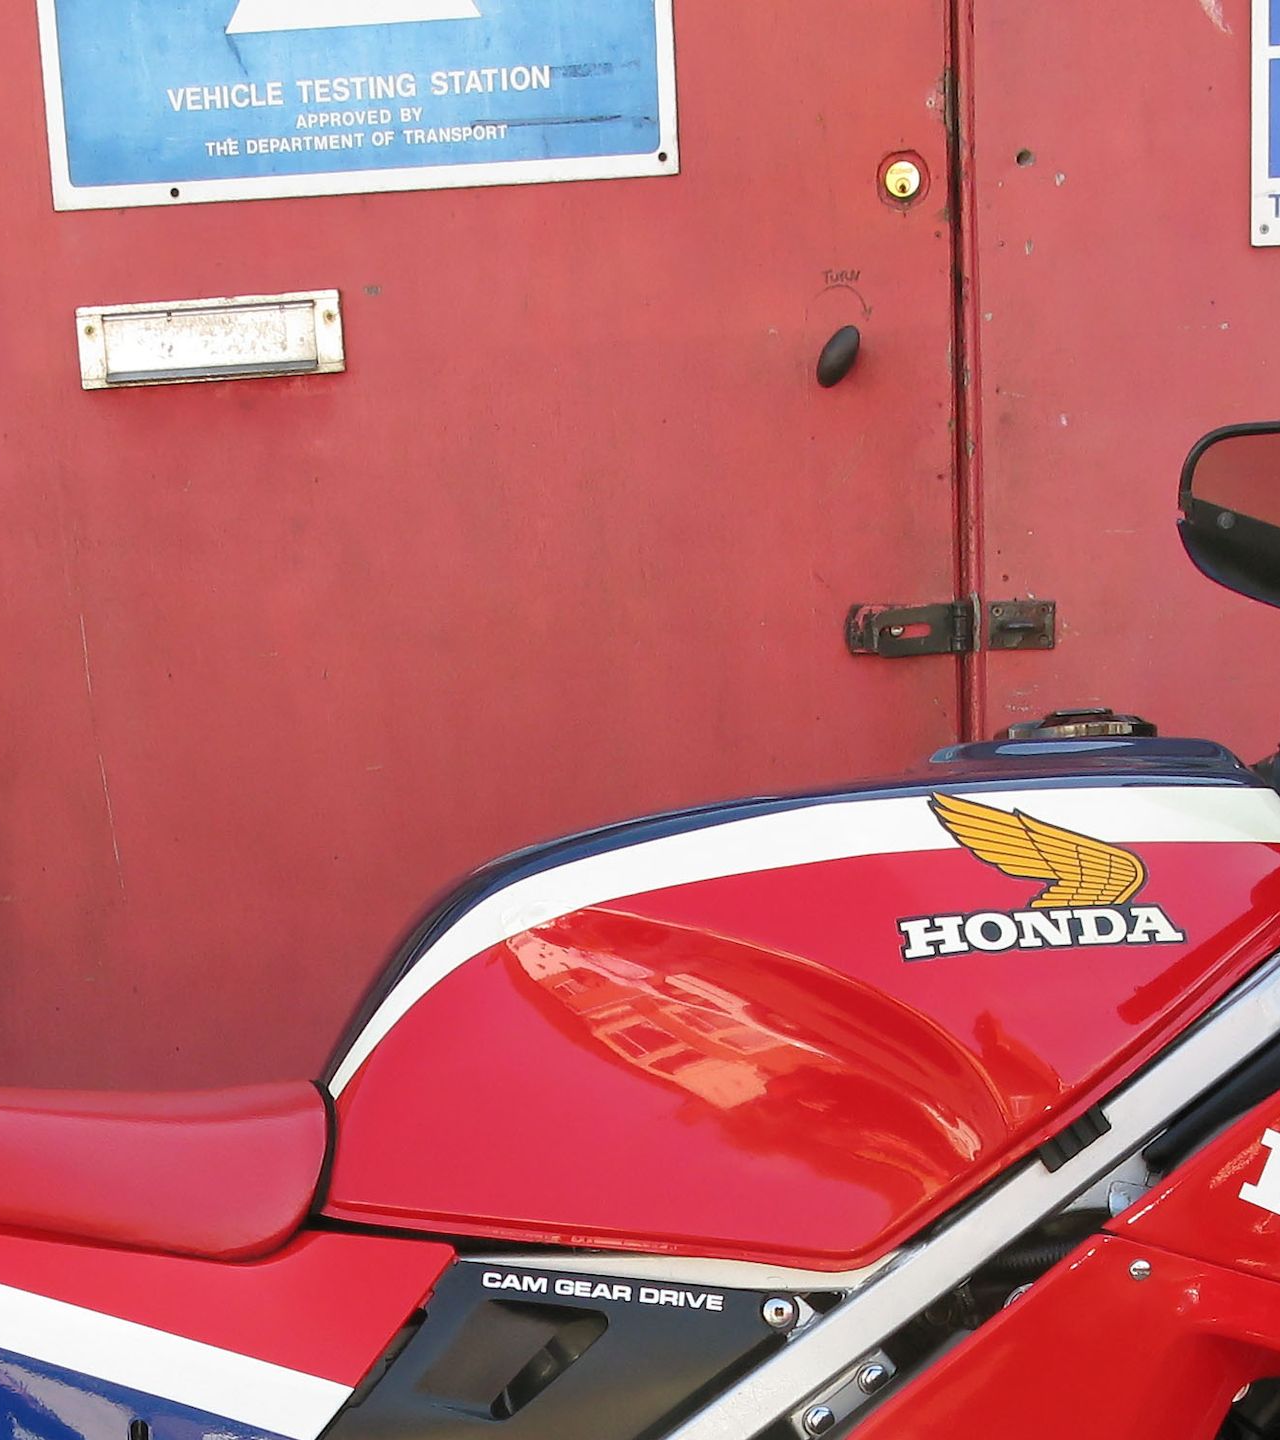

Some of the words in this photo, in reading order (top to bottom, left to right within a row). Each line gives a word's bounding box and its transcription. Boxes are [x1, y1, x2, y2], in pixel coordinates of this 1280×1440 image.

[167, 82, 283, 112] VEHICLE
[296, 72, 417, 104] TESTING
[431, 65, 551, 96] STATION
[295, 108, 392, 129] APPROVED
[400, 106, 423, 123] BY
[204, 138, 239, 157] THE
[246, 132, 365, 154] DEPARTMENT
[371, 130, 395, 146] OF
[403, 124, 508, 145] TRANSPORT
[899, 905, 1185, 960] HONDA
[482, 1271, 549, 1293] CAM
[554, 1278, 632, 1302] GEAR
[639, 1287, 724, 1311] DRIVE
